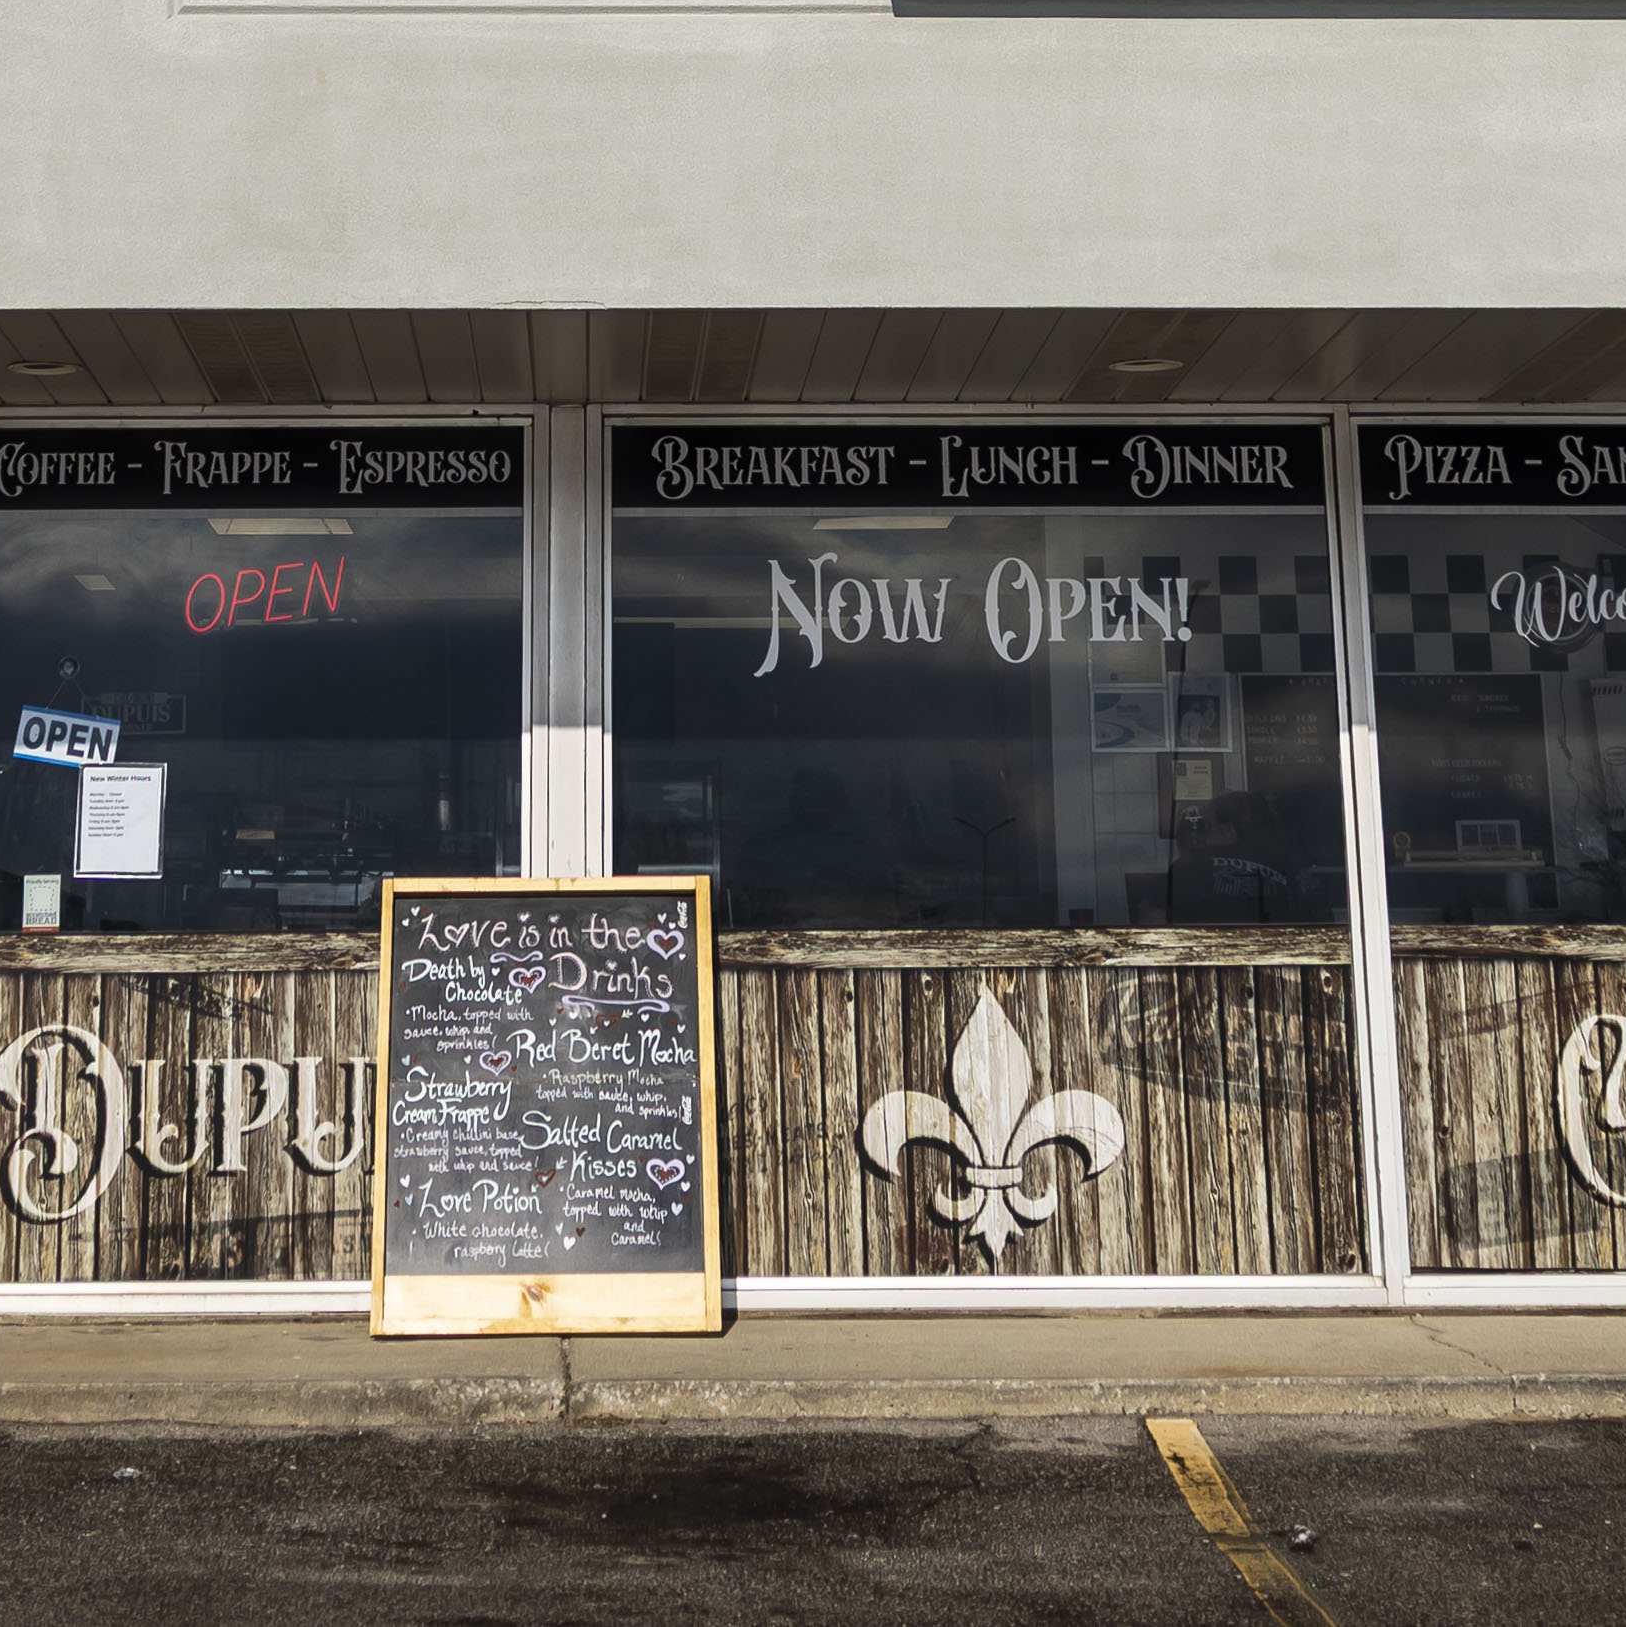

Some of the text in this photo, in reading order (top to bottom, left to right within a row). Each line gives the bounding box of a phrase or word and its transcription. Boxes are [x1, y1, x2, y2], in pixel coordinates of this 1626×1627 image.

[185, 556, 346, 633] OPEN
[23, 716, 113, 762] OPEN
[418, 912, 511, 952] Love
[518, 912, 541, 949] is
[548, 913, 573, 948] in
[581, 912, 645, 952] the
[401, 955, 485, 989] Death by
[548, 952, 673, 999] Drinks
[445, 980, 523, 1005] Chocolate
[463, 1007, 501, 1023] topped
[507, 1007, 534, 1021] with
[473, 1022, 493, 1035] and
[506, 1028, 697, 1068] Red Beret Mocha
[549, 1068, 664, 1092] Raspberry Mocha
[404, 1066, 512, 1121] Strawberry
[536, 1085, 567, 1101] topped
[572, 1087, 594, 1099] with
[392, 1098, 490, 1133] Cream Frappe
[615, 1102, 634, 1114] and
[406, 1127, 449, 1148] Creamy
[520, 1110, 683, 1153] Salted Caramel
[489, 1143, 523, 1160] topped
[454, 1159, 475, 1173] whip
[479, 1159, 499, 1172] and
[570, 1150, 637, 1182] Kisses
[418, 1177, 542, 1218] Love Potion
[566, 1183, 615, 1200] Caramel
[563, 1201, 668, 1224] topped with whip
[423, 1220, 467, 1239] White
[624, 1220, 645, 1233] and
[454, 1241, 506, 1268] raspberry
